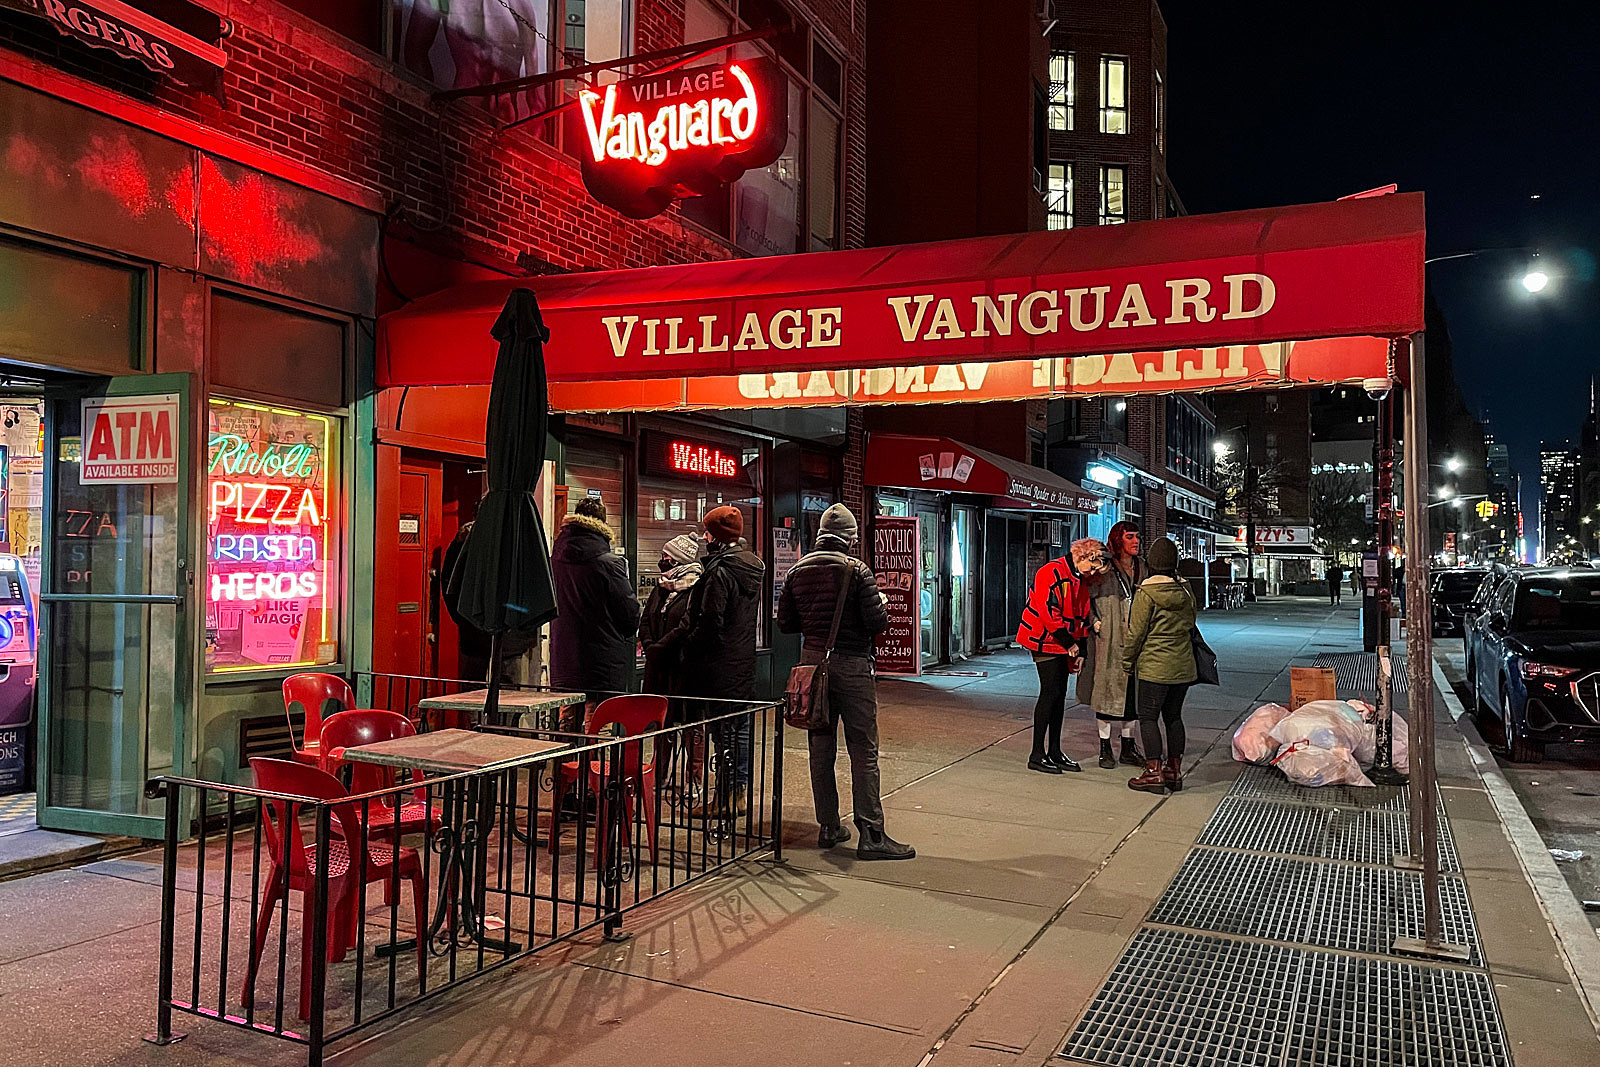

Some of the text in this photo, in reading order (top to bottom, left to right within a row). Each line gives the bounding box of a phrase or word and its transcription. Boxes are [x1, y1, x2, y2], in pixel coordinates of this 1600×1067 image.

[24, 0, 175, 69] RGERS
[632, 70, 725, 102] VILLAGE
[579, 64, 758, 166] Vanguard
[601, 273, 1276, 357] VILLAGE VANGUARD
[88, 410, 172, 461] ATM
[85, 464, 175, 478] AVAILABLE INSIDE
[673, 443, 735, 476] Walk-Ins
[210, 481, 319, 526] PIZZA
[875, 529, 912, 553] PSYCHIC
[875, 555, 912, 570] READINGS
[211, 572, 317, 602] HEROS
[266, 601, 298, 611] LIKE
[886, 614, 913, 625] Cleansing
[889, 627, 910, 636] Coach
[874, 646, 912, 657] 365-2449
